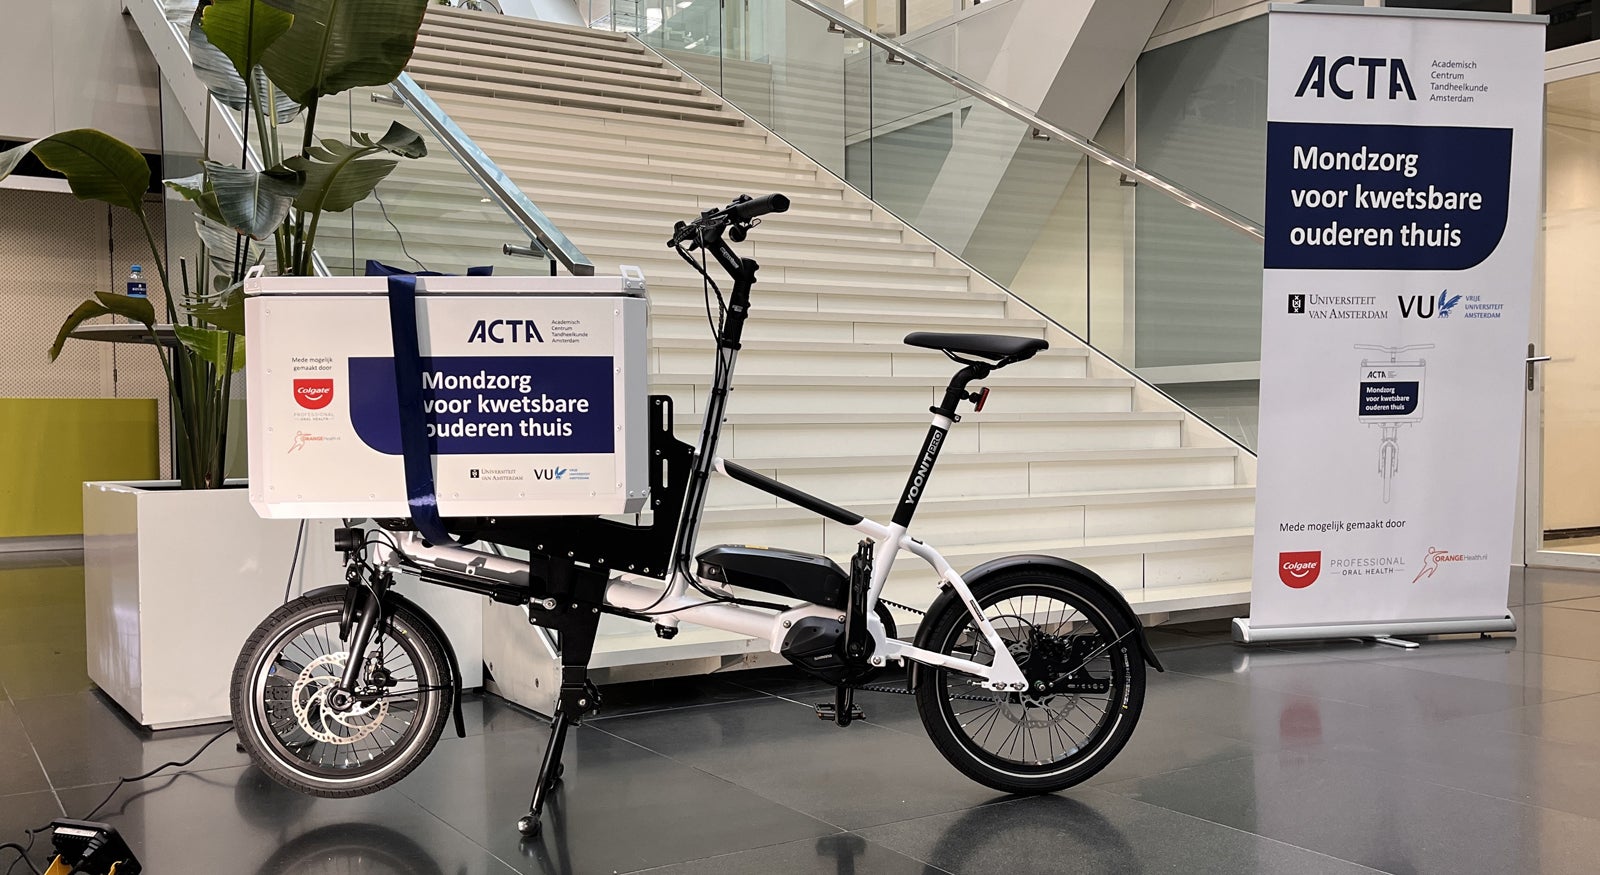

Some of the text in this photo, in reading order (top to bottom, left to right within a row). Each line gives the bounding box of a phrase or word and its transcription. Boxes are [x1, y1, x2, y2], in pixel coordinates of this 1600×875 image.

[1431, 60, 1477, 69] Academisch
[1294, 55, 1417, 101] ACTA
[1431, 71, 1465, 80] Centrum
[1430, 82, 1489, 93] Tandheelkunde
[1430, 94, 1474, 103] Amsterdam
[1293, 145, 1419, 178] Mondzorg
[1291, 183, 1482, 210] voor kwetsbare
[1290, 221, 1461, 247] ouderen thuis
[1309, 294, 1376, 305] UNIVERSITEIT
[1398, 295, 1435, 319] VU
[1329, 308, 1388, 319] AMSTERDAM
[467, 319, 545, 343] ACTA
[309, 357, 333, 365] mogelijk
[1367, 370, 1387, 379] ACTA
[422, 370, 532, 393] Mondzorg
[297, 387, 330, 395] Colgate
[423, 394, 589, 414] voor kwetsbare
[519, 418, 573, 437] thuis
[534, 469, 554, 480] VU
[905, 451, 933, 504] YOONIT
[1279, 519, 1406, 533] Mede mogelijk gemaakt door
[1283, 561, 1317, 571] Colgate
[1330, 556, 1406, 568] PROFESSIONAL
[1342, 567, 1394, 576] ORAL HEALTH
